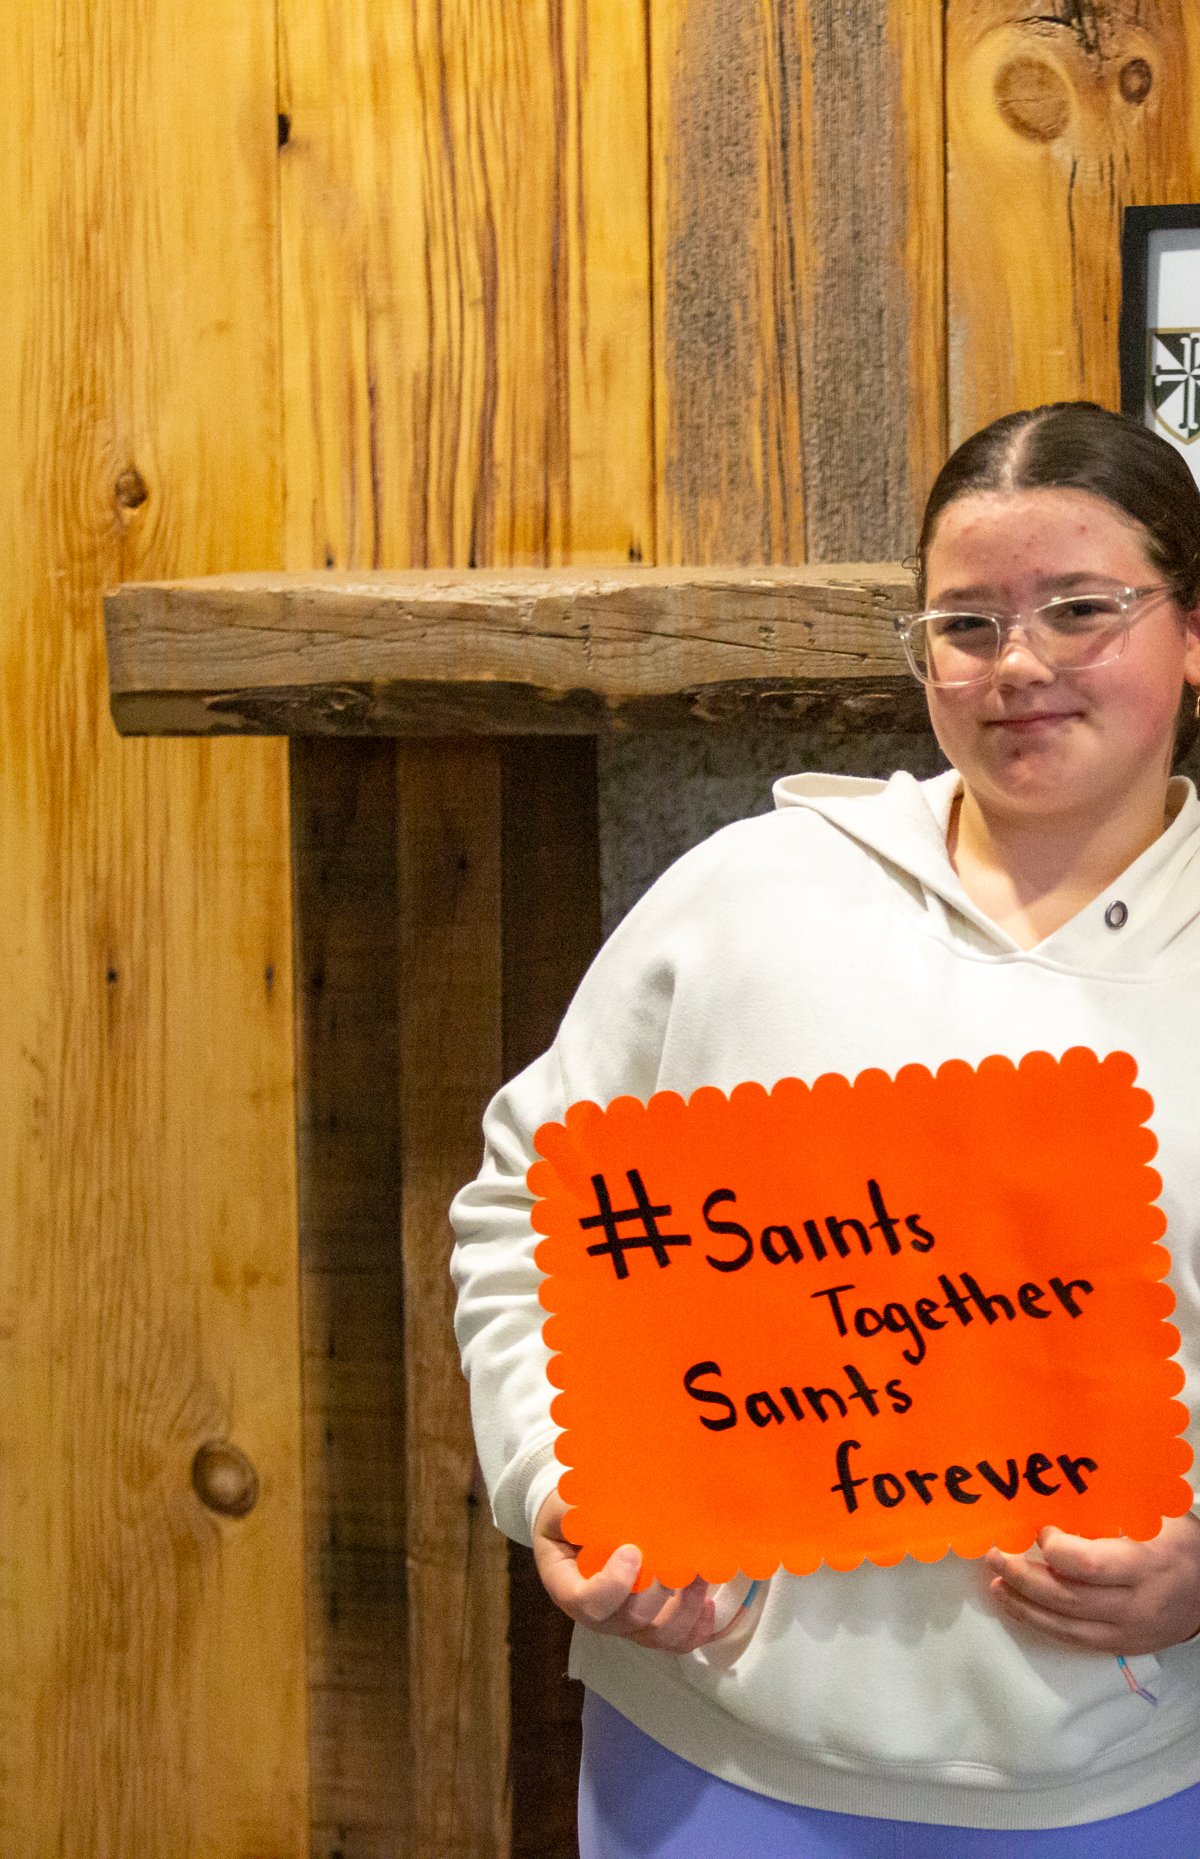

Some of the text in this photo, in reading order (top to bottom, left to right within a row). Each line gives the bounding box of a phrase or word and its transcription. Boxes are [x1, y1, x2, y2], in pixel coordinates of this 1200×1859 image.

[579, 1168, 935, 1280] #Saints
[811, 1272, 1094, 1365] Together
[683, 1360, 913, 1432] Saints
[831, 1440, 1098, 1513] forever
